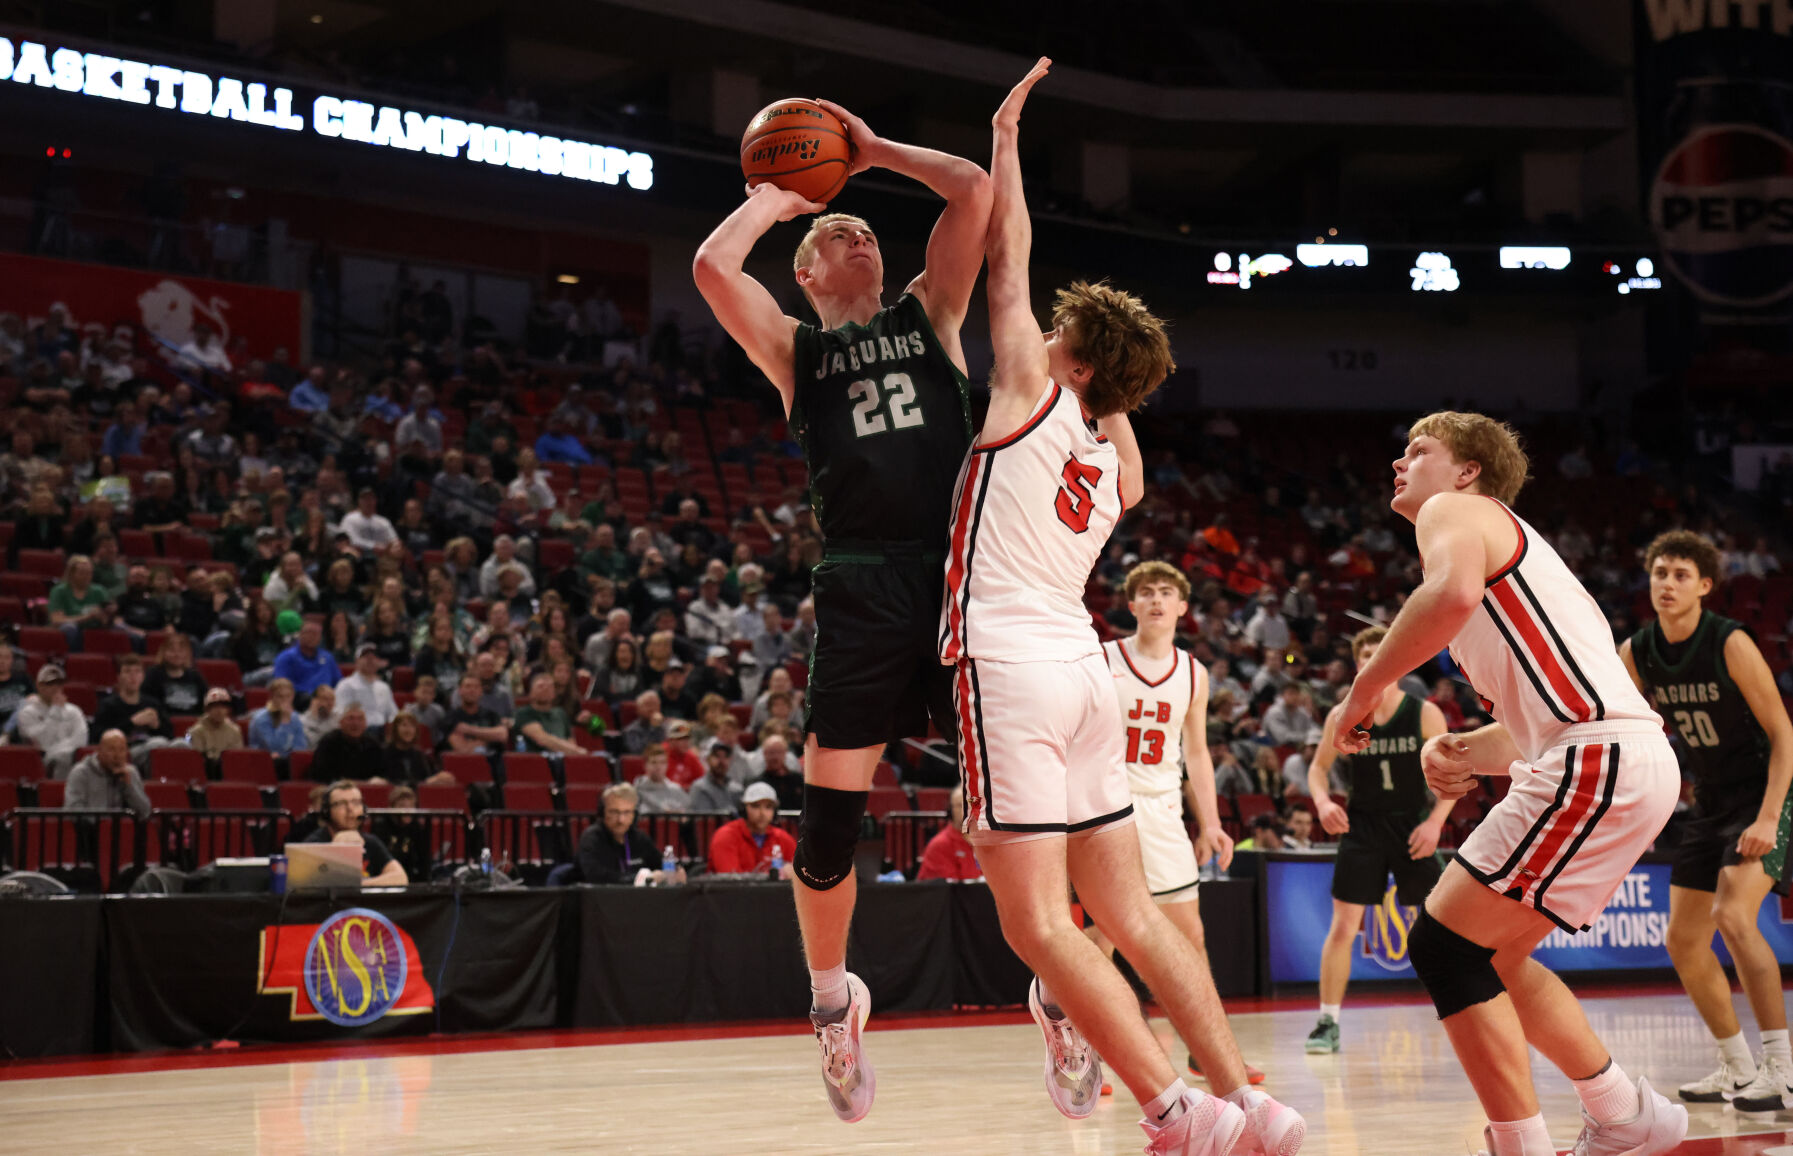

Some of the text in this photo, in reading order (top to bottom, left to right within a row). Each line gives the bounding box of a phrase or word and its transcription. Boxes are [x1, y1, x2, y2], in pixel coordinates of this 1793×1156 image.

[313, 95, 653, 190] CHAMPIONSHIPS
[752, 139, 821, 165] Baden
[815, 330, 926, 380] JAGUARS
[1327, 351, 1377, 370] 120
[847, 372, 924, 438] 22
[1054, 451, 1103, 534] 5
[1128, 698, 1171, 723] J-B
[1656, 682, 1720, 704] AGUARS
[1126, 726, 1165, 765] 13
[1360, 735, 1417, 755] GUARS
[1674, 710, 1720, 748] 20
[1380, 760, 1394, 790] 1
[1606, 873, 1652, 908] ATE
[1536, 911, 1669, 949] HAMPIONS
